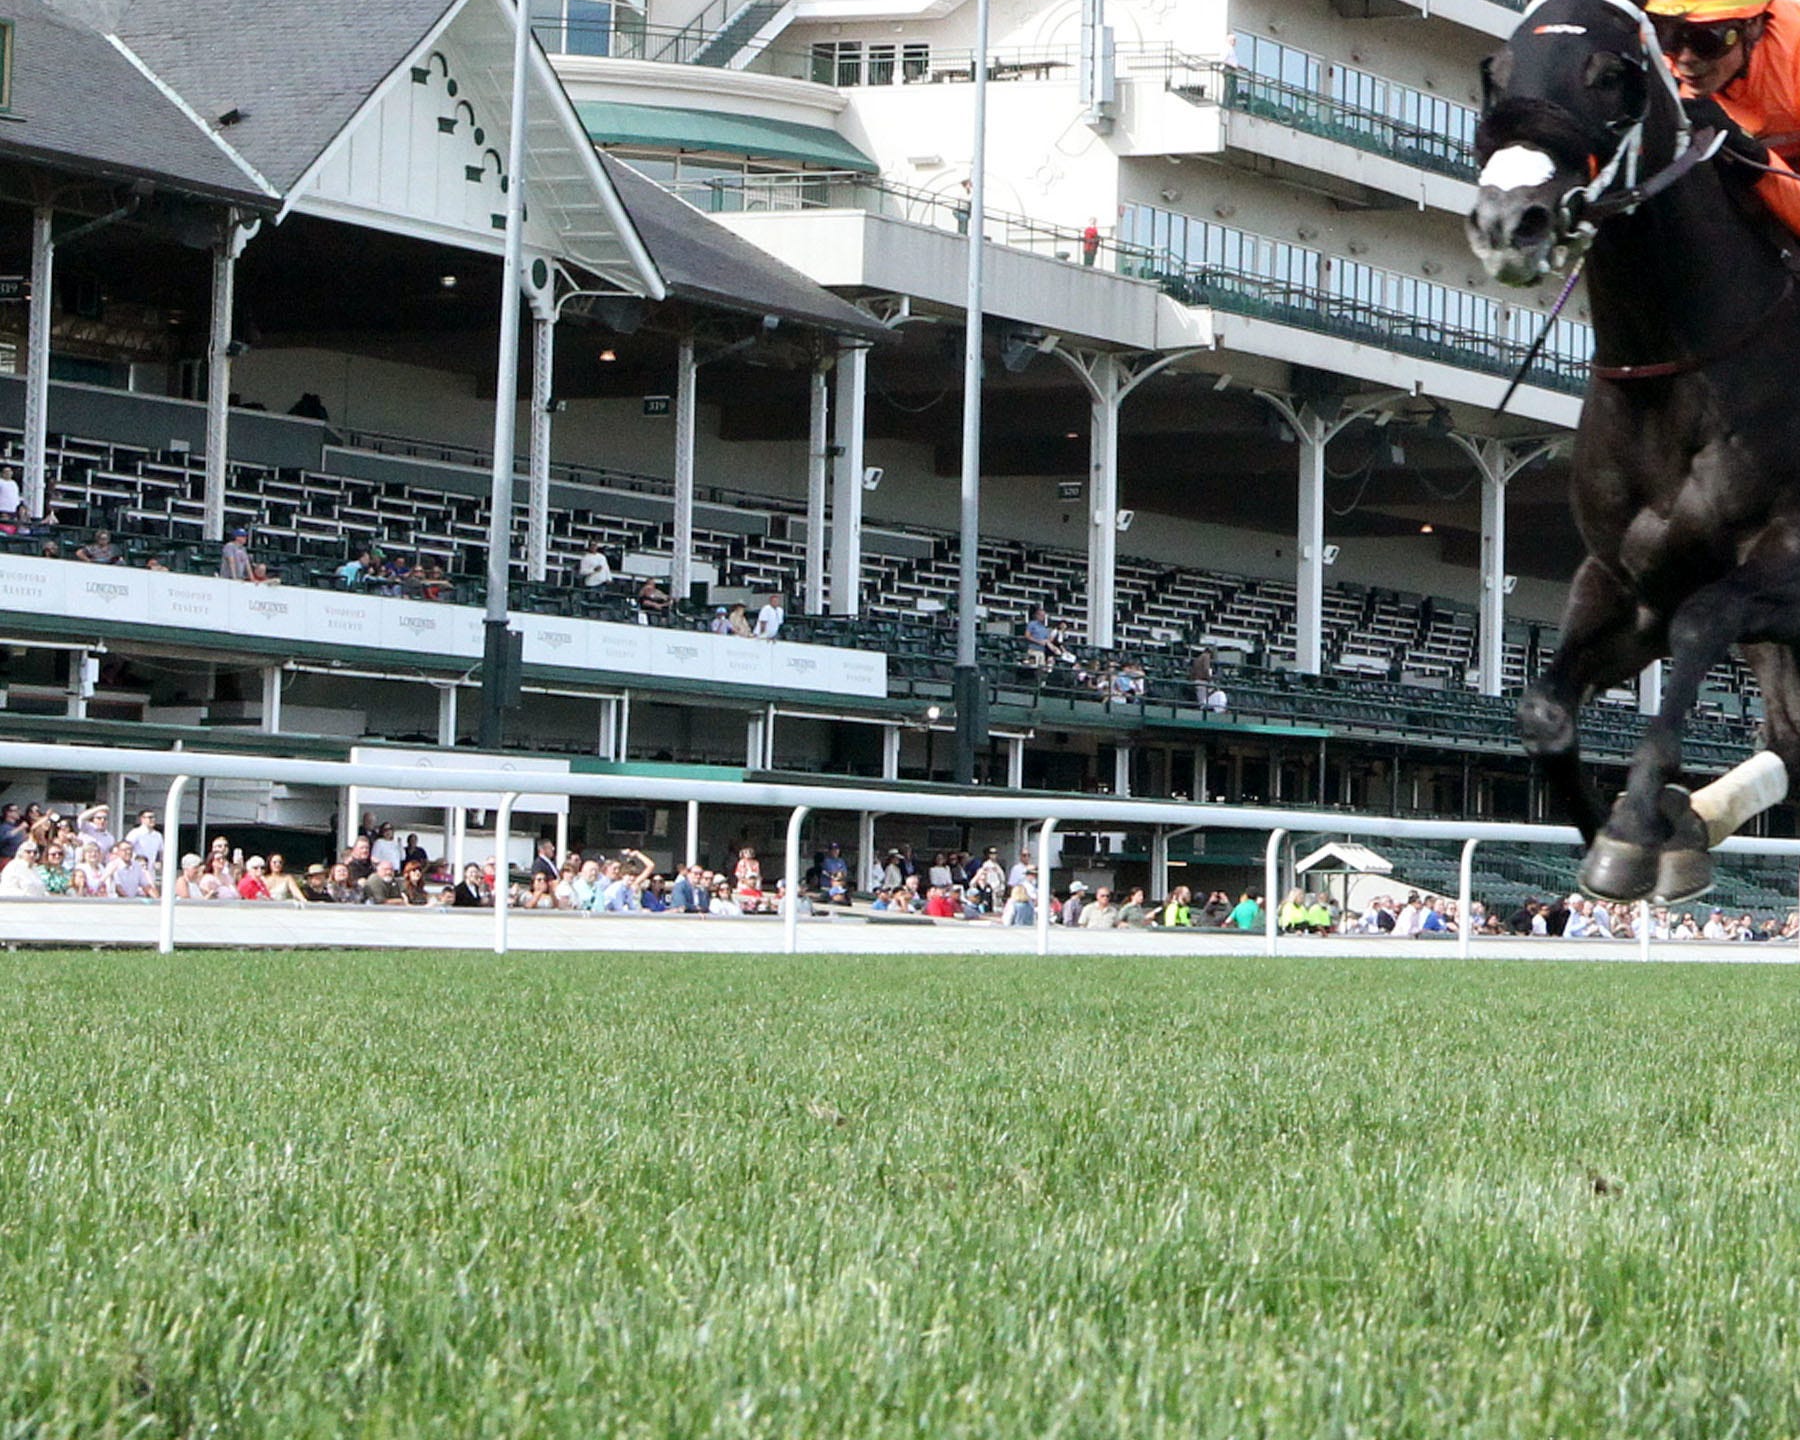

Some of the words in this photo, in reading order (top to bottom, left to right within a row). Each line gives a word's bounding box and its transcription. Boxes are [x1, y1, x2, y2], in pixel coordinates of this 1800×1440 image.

[86, 581, 129, 597] LONGINES
[248, 599, 289, 614] LONGINES
[398, 615, 436, 630] LONGINES
